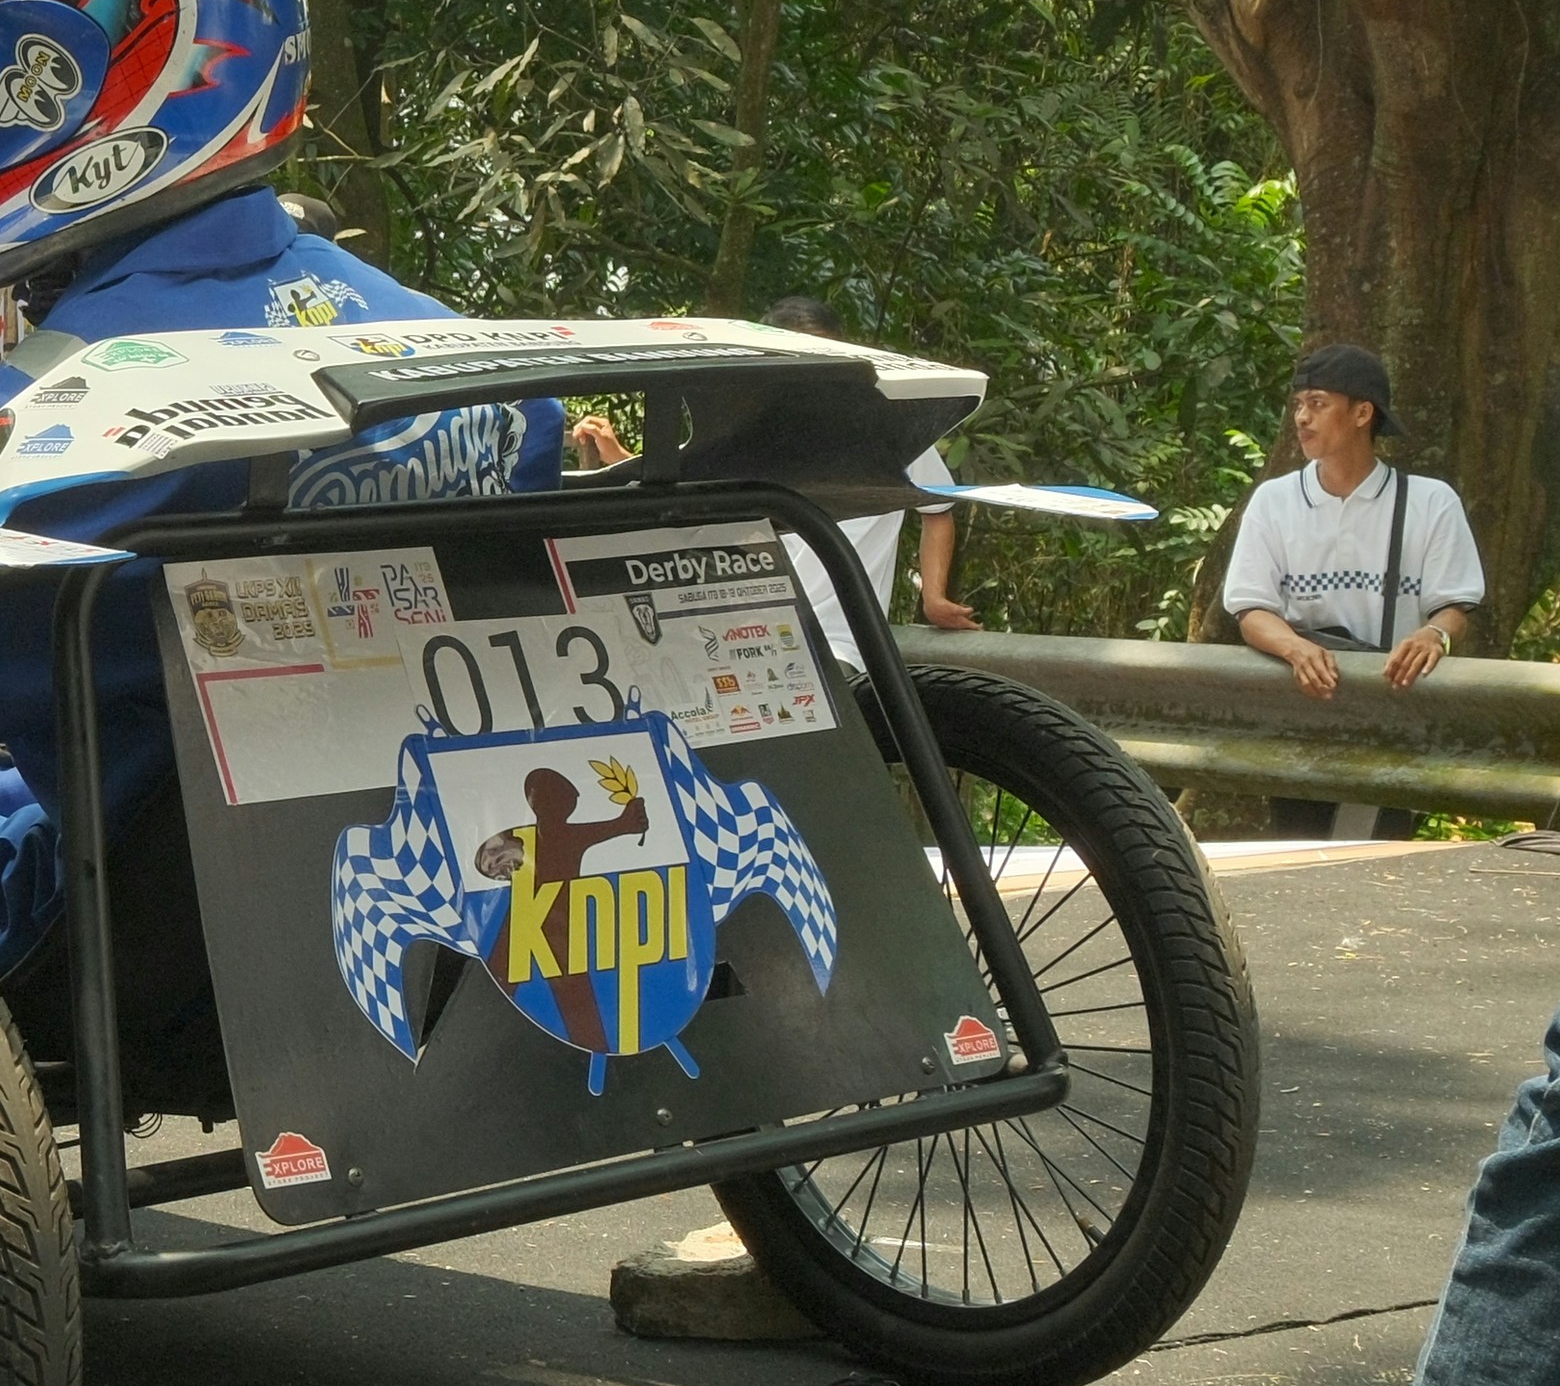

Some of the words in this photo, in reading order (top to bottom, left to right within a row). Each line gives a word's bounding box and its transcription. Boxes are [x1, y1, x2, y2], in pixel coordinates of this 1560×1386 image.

[16, 51, 51, 103] MOON
[401, 332, 475, 346] DPD
[480, 329, 564, 342] KNPI
[422, 341, 505, 352] KABUPATEN
[368, 354, 591, 382] KABUPATEN
[594, 347, 767, 365] BANDUNG
[625, 552, 708, 585] Derby
[714, 550, 775, 576] Race
[235, 579, 276, 600] LKPS
[278, 576, 302, 599] XII
[241, 597, 310, 624] DAMAS
[272, 620, 316, 641] 2025
[736, 645, 764, 661] FORK
[422, 625, 624, 738] 013
[670, 706, 707, 721] Accola
